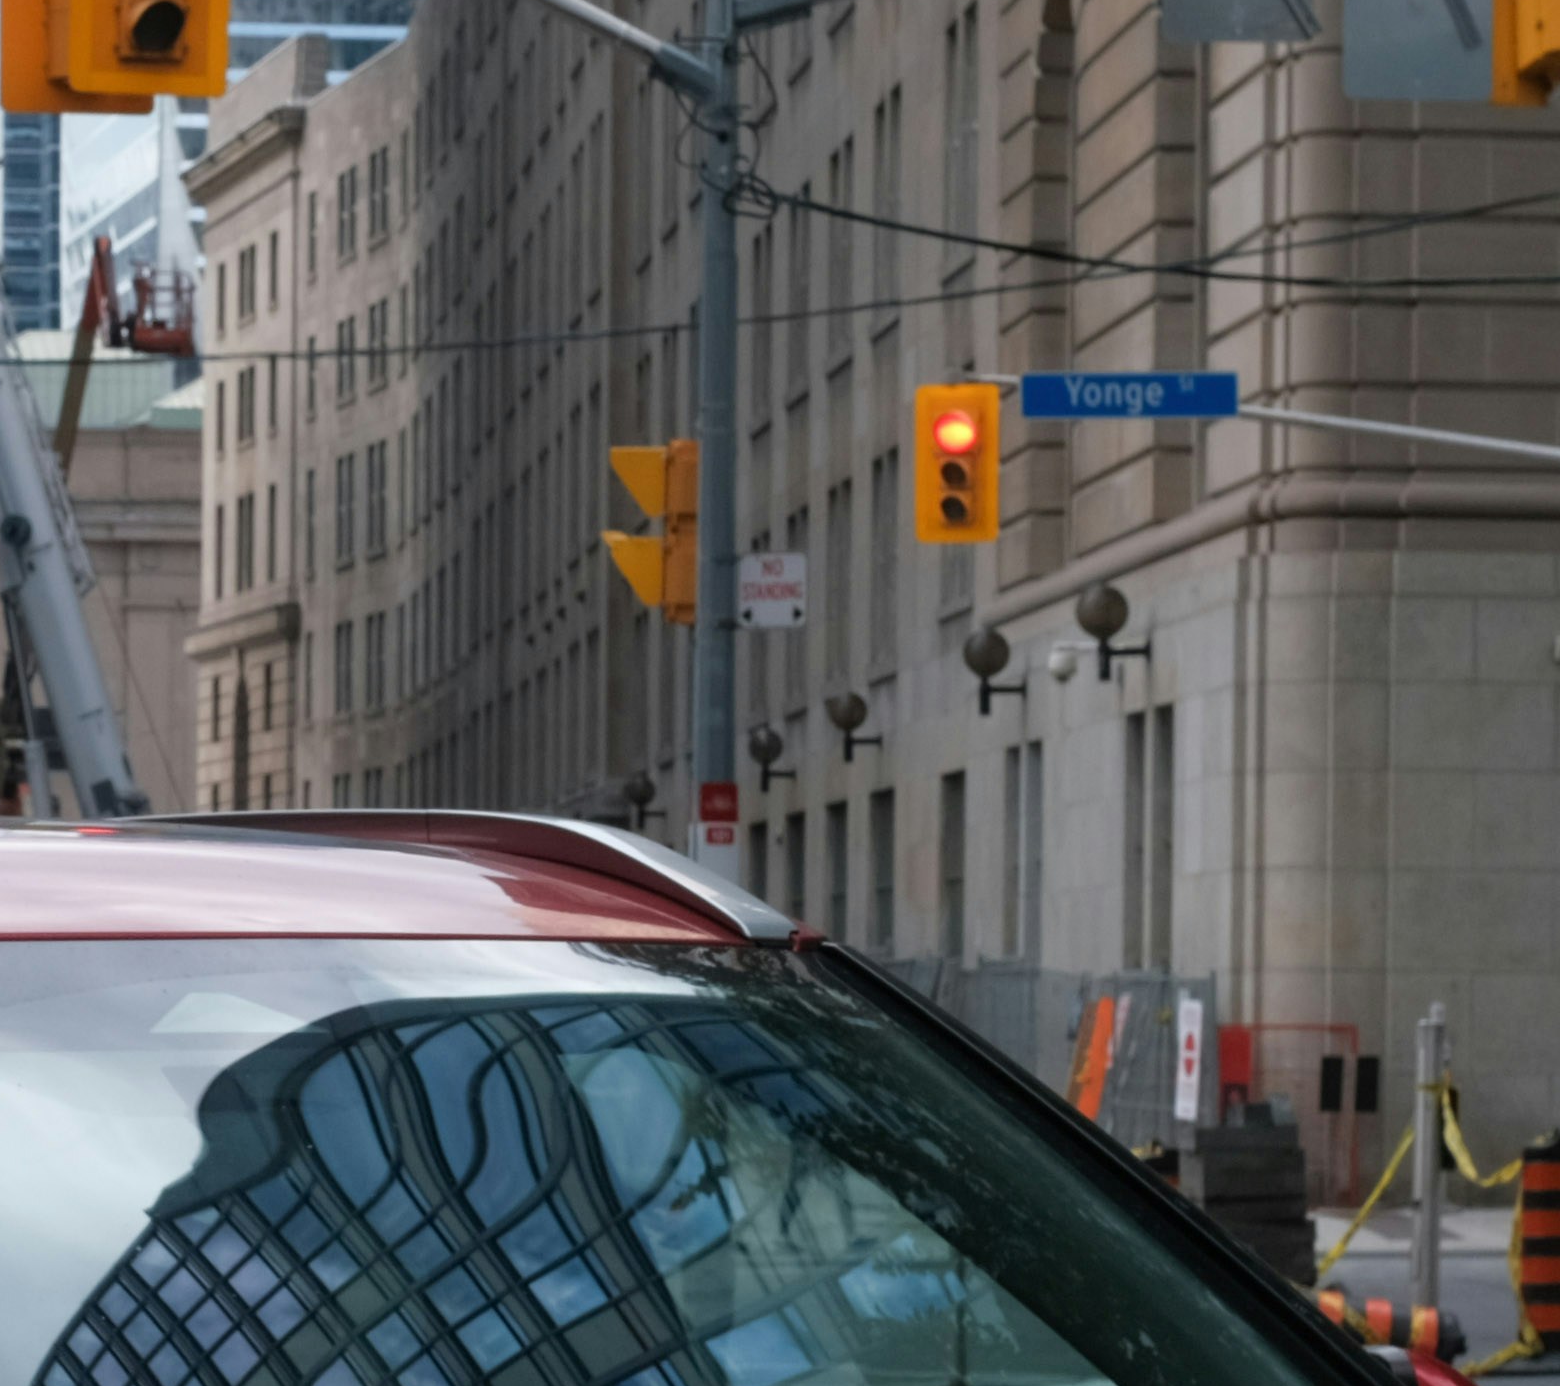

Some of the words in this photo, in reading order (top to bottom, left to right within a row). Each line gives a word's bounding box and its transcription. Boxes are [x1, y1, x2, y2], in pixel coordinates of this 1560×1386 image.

[1064, 375, 1164, 414] Yonge
[762, 558, 784, 577] NO
[743, 581, 803, 601] STANDING
